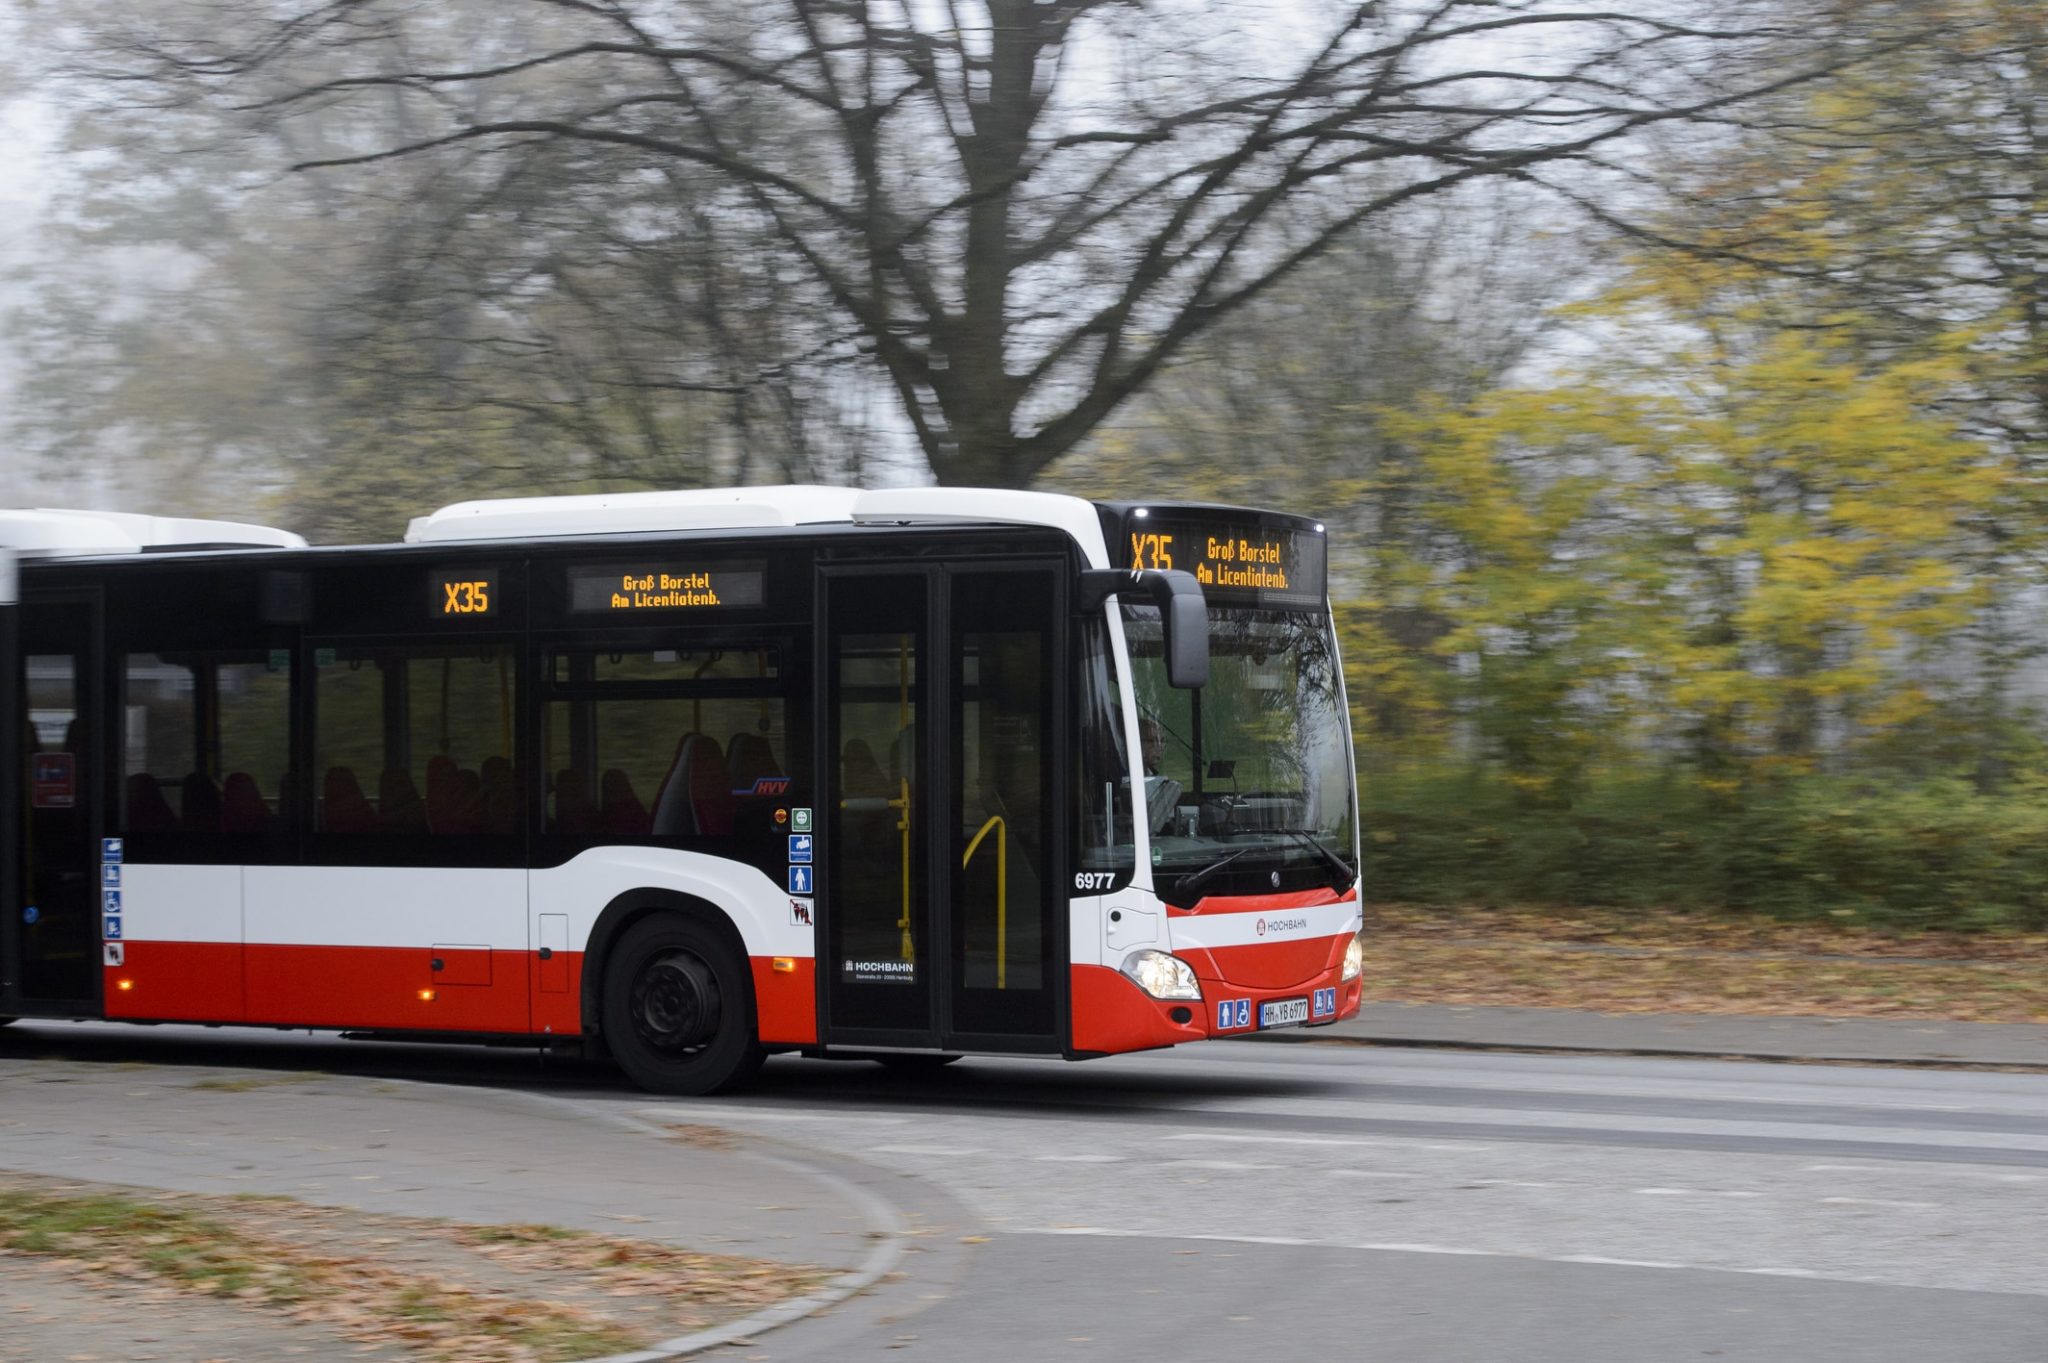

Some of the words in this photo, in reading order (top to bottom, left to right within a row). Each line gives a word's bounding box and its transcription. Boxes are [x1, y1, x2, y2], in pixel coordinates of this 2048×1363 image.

[1131, 533, 1172, 570] X35
[1207, 537, 1234, 562] Groß
[1240, 540, 1280, 563] Borstel
[623, 575, 655, 591] Groß
[660, 573, 710, 590] Borstel
[1197, 562, 1213, 585] Am
[1217, 563, 1289, 588] Licentiatenb.
[444, 582, 488, 613] X35
[611, 593, 630, 608] Am
[635, 591, 720, 607] Licentiatenb.
[758, 781, 789, 793] HVV
[1075, 872, 1116, 890] 6977
[1267, 919, 1307, 931] HOCHBAHN
[855, 962, 914, 972] HOCHBAHN
[1264, 1004, 1275, 1023] HH
[1279, 1003, 1288, 1020] YB
[1289, 1001, 1307, 1018] 6977
